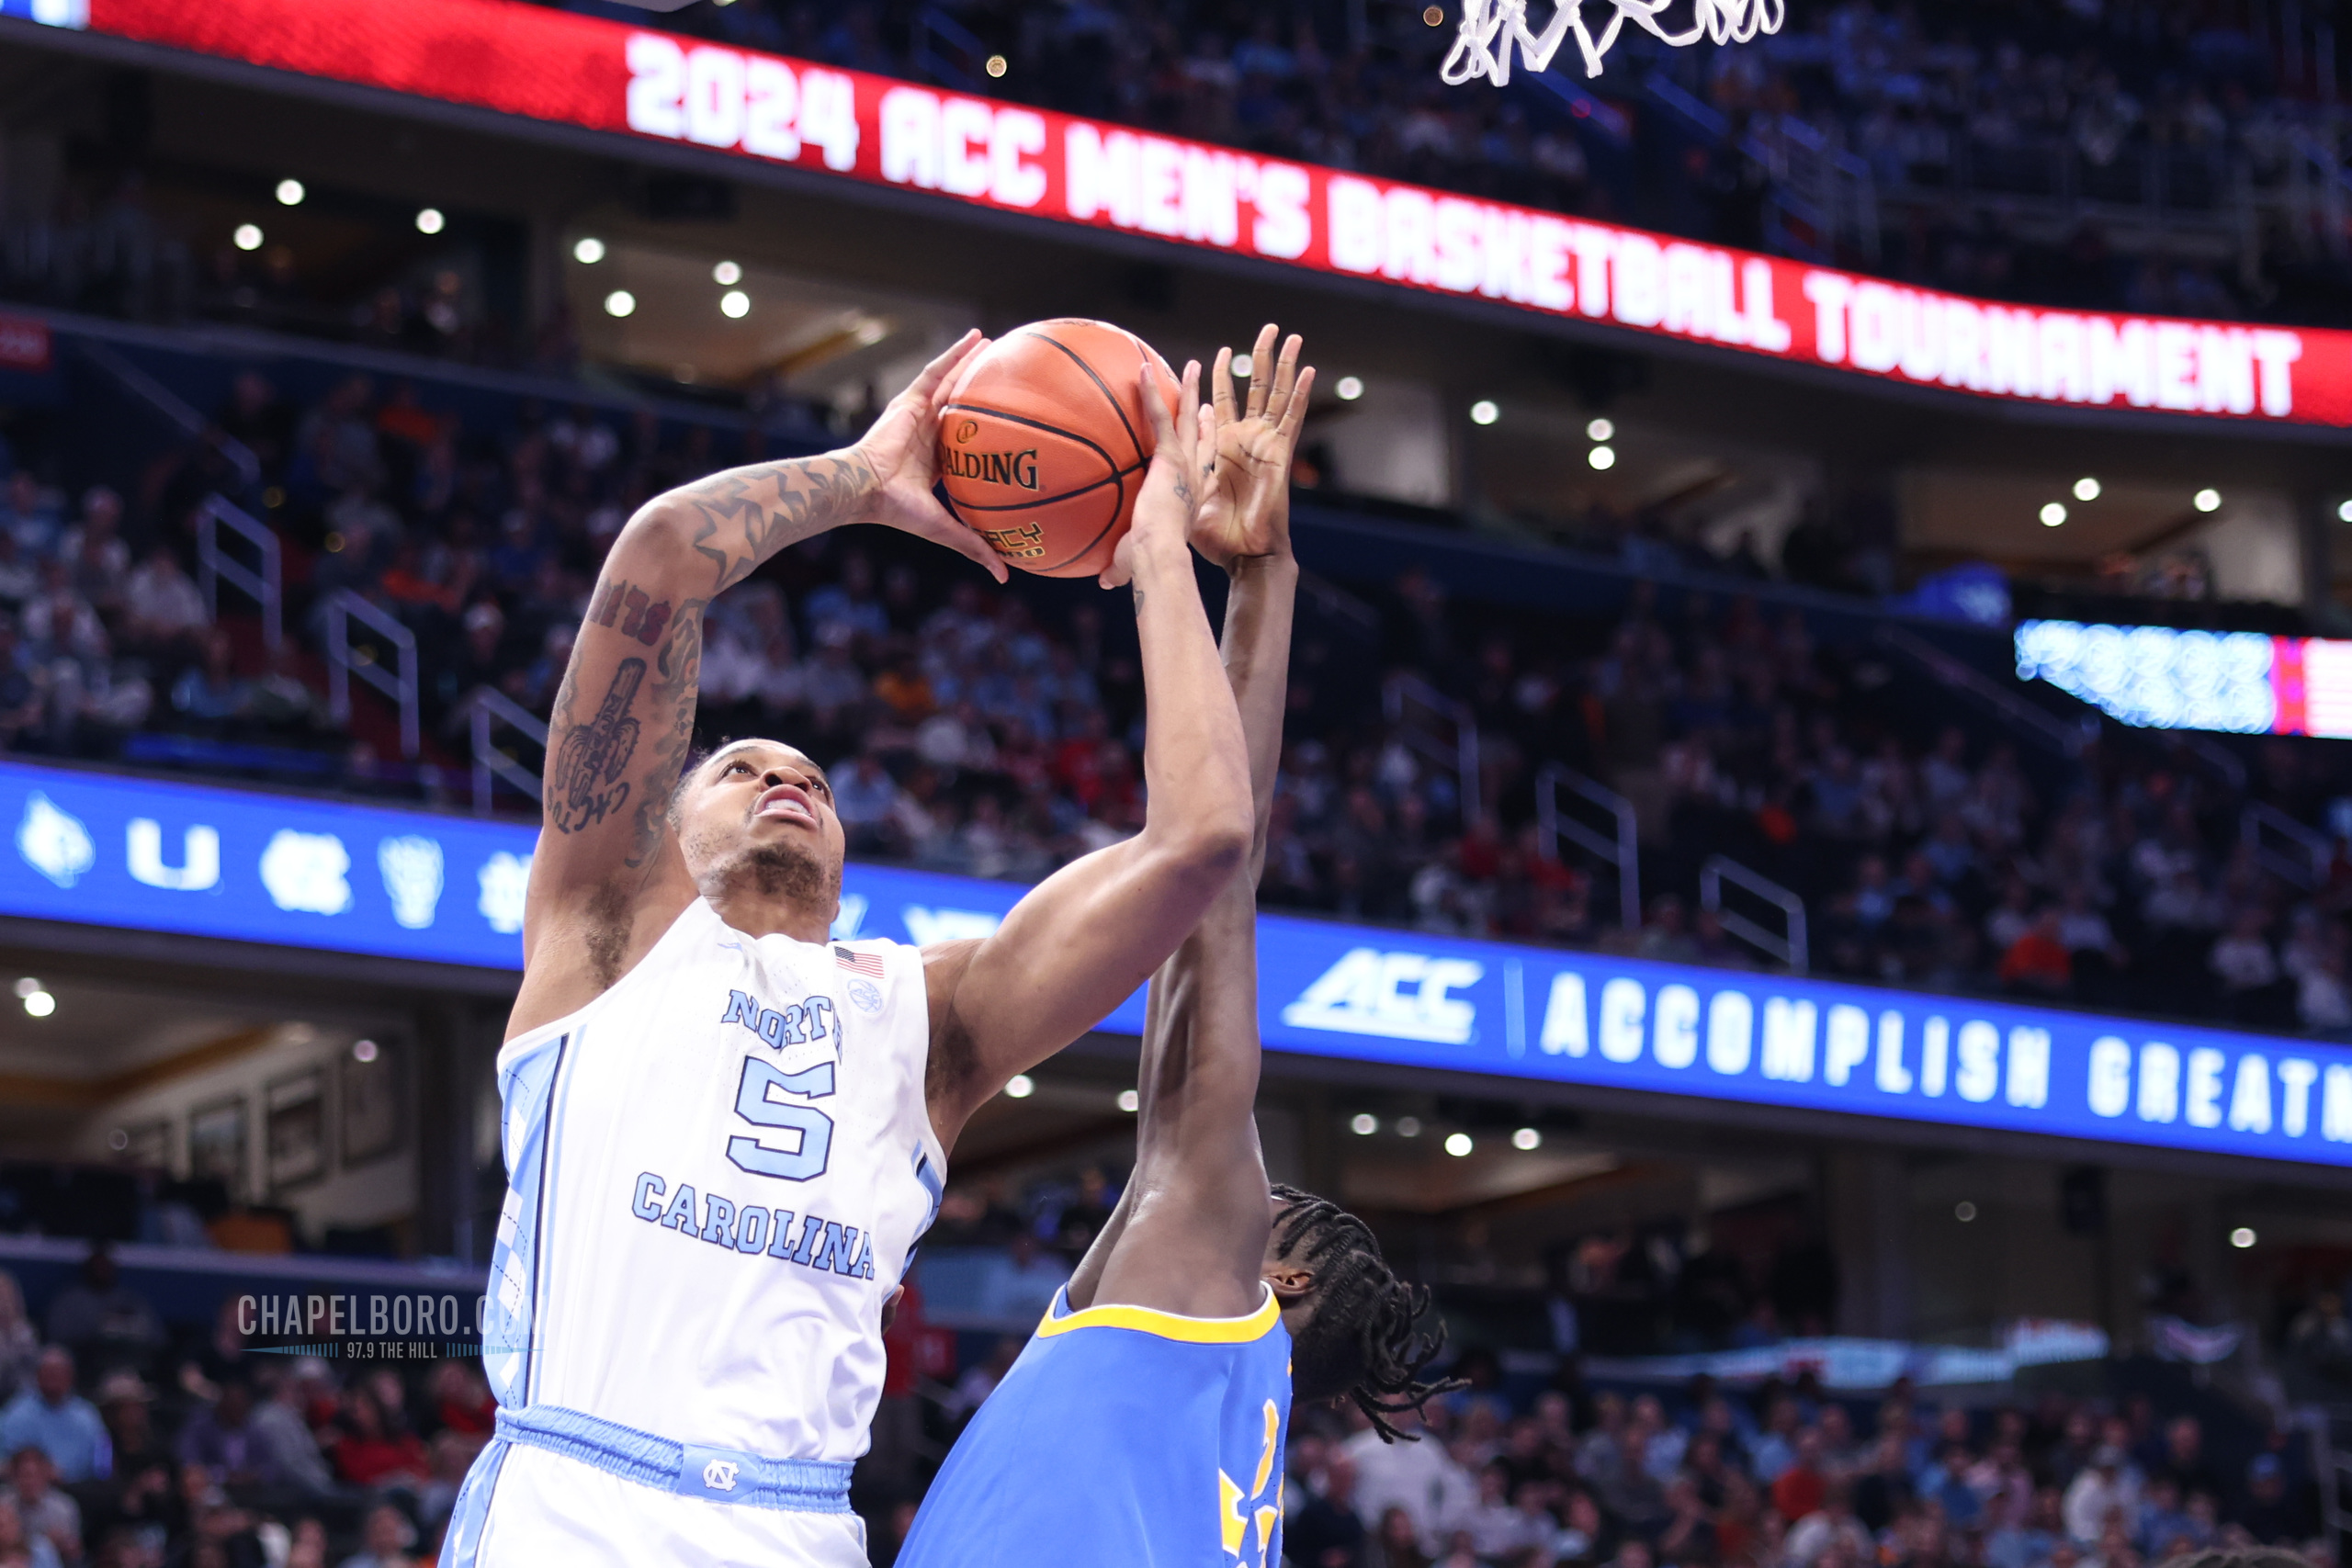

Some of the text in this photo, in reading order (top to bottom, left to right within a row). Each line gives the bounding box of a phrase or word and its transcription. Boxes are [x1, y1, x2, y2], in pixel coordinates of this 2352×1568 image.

[626, 34, 2301, 416] 2024 ACC MEN'S BASKETBALL TOURNAMENT
[128, 818, 220, 889] U
[1285, 949, 1481, 1044] ACC
[1542, 974, 2050, 1108] ACCOMPLISH
[726, 1055, 835, 1182] 5
[632, 1171, 875, 1280] CAROLINA
